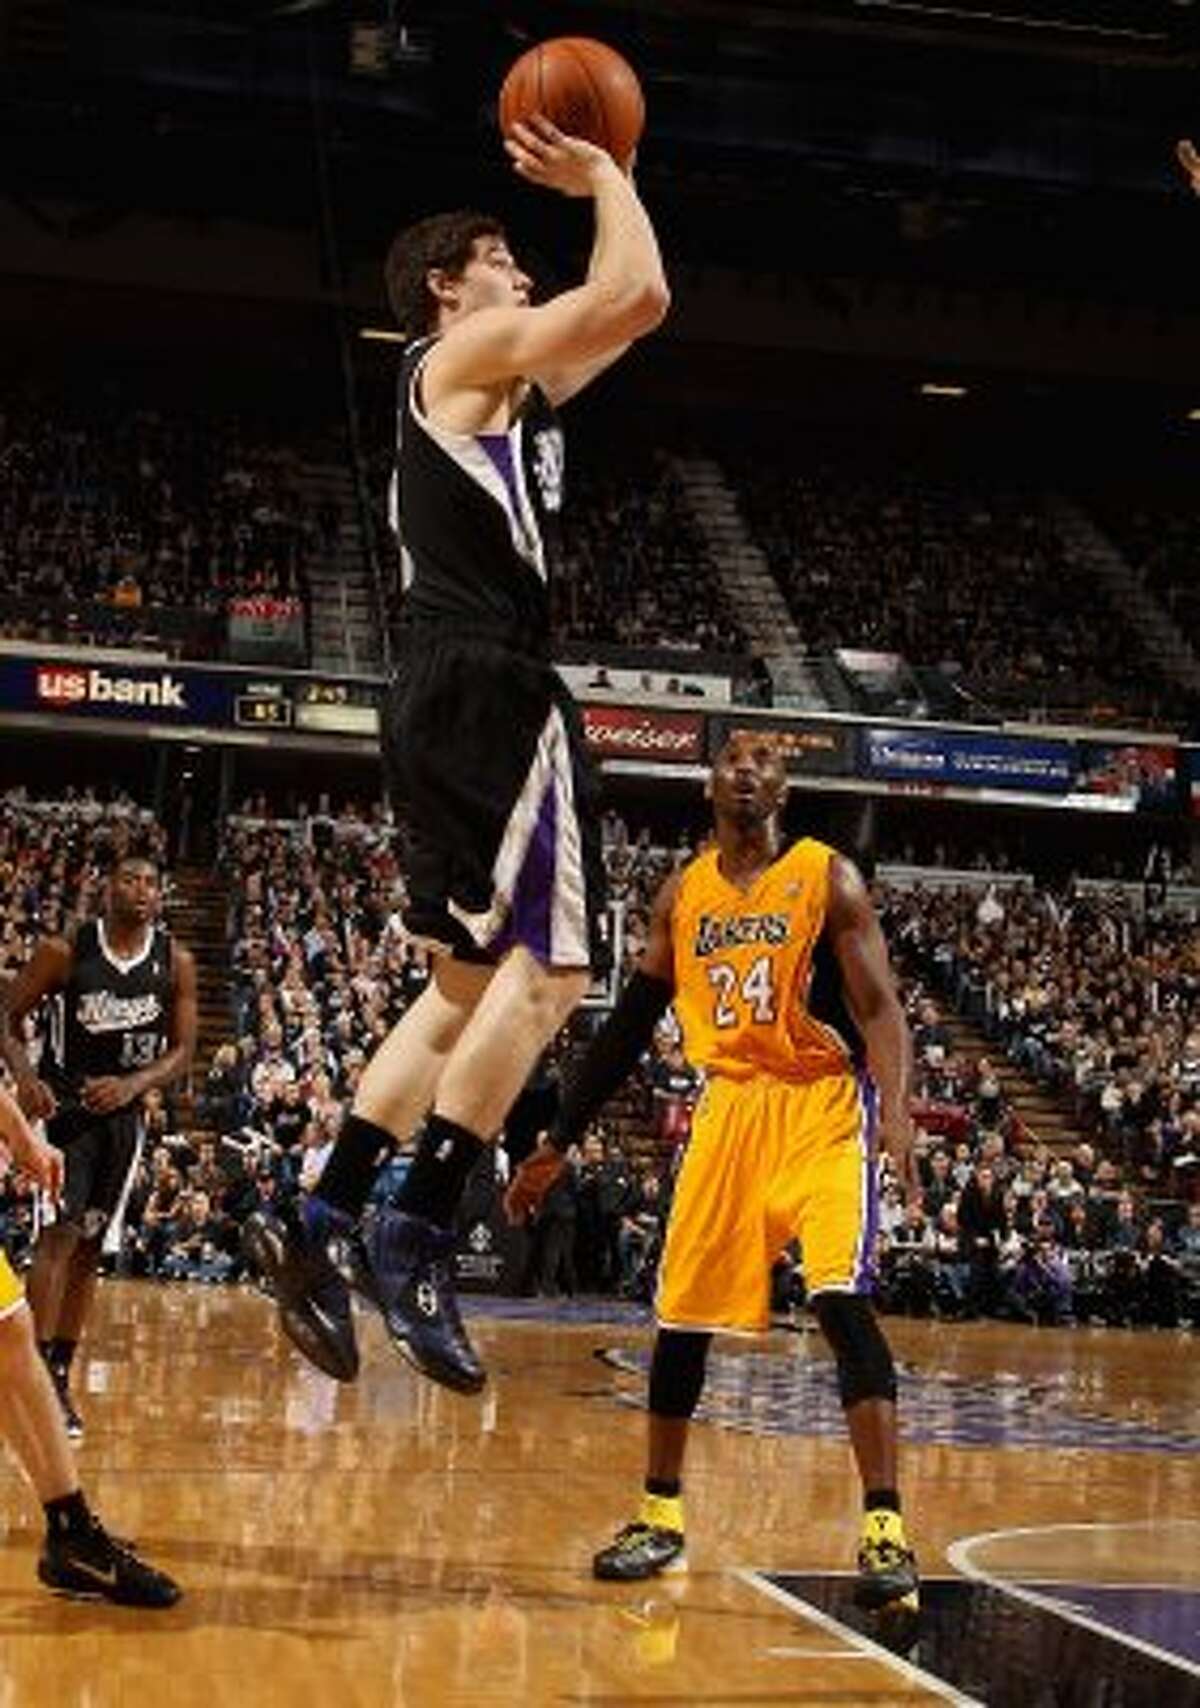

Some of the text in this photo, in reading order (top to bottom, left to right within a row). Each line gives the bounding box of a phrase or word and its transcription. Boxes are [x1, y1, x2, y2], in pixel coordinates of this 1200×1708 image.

[584, 711, 698, 749] weiser
[695, 913, 788, 956] LAKERS
[706, 956, 777, 1028] 24
